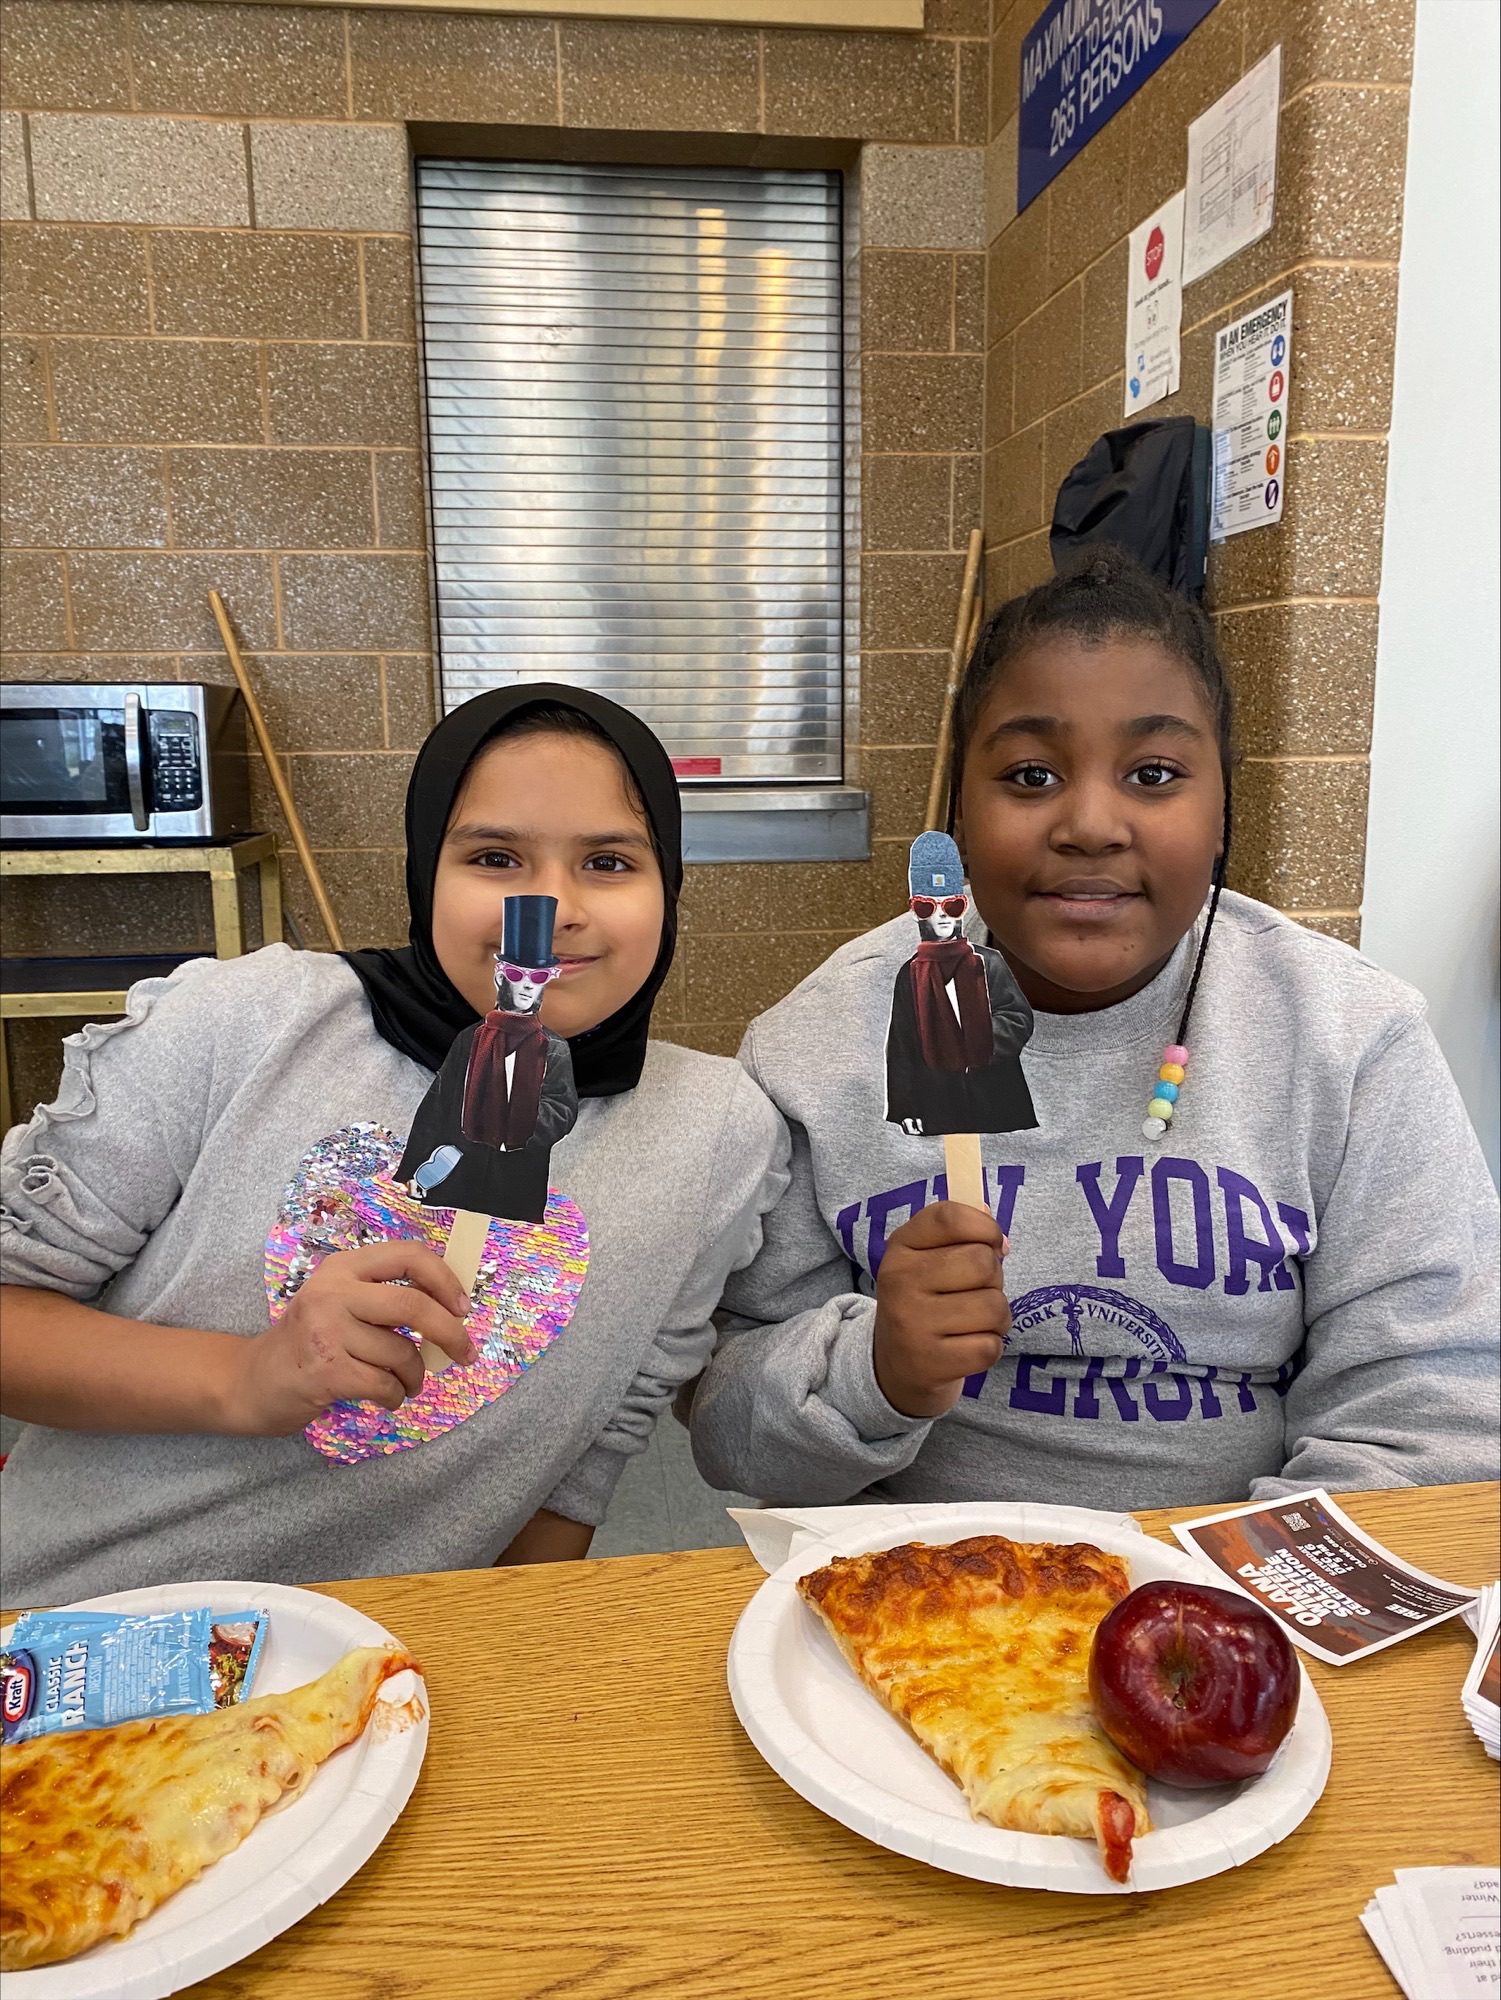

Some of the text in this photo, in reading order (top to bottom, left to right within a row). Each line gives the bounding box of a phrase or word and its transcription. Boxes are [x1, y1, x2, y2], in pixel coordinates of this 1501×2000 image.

[1023, 0, 1090, 103] MAXIMUM
[1061, 37, 1083, 92] NOT
[1085, 17, 1100, 62] TO
[1050, 0, 1162, 157] 265 PERSONS
[1220, 299, 1288, 352] IN AN EMERGENCY
[1013, 1304, 1057, 1334] YORK
[1296, 1545, 1338, 1576] SATURDAY
[1304, 1543, 1347, 1574] DEC 16
[1316, 1544, 1335, 1557] PM
[1237, 1562, 1322, 1626] OLANA
[1258, 1564, 1331, 1620] WINTER
[1264, 1554, 1353, 1617] SOLSTICE
[1275, 1548, 1371, 1615] CELEBRATION
[1385, 1603, 1428, 1620] FREE
[9, 1679, 23, 1710] Kraft
[46, 1655, 62, 1713] CLASSIC
[62, 1639, 88, 1727] RANCH
[88, 1655, 103, 1694] DRESSING
[1461, 1894, 1500, 1902] Winter
[1470, 1960, 1496, 1968] their
